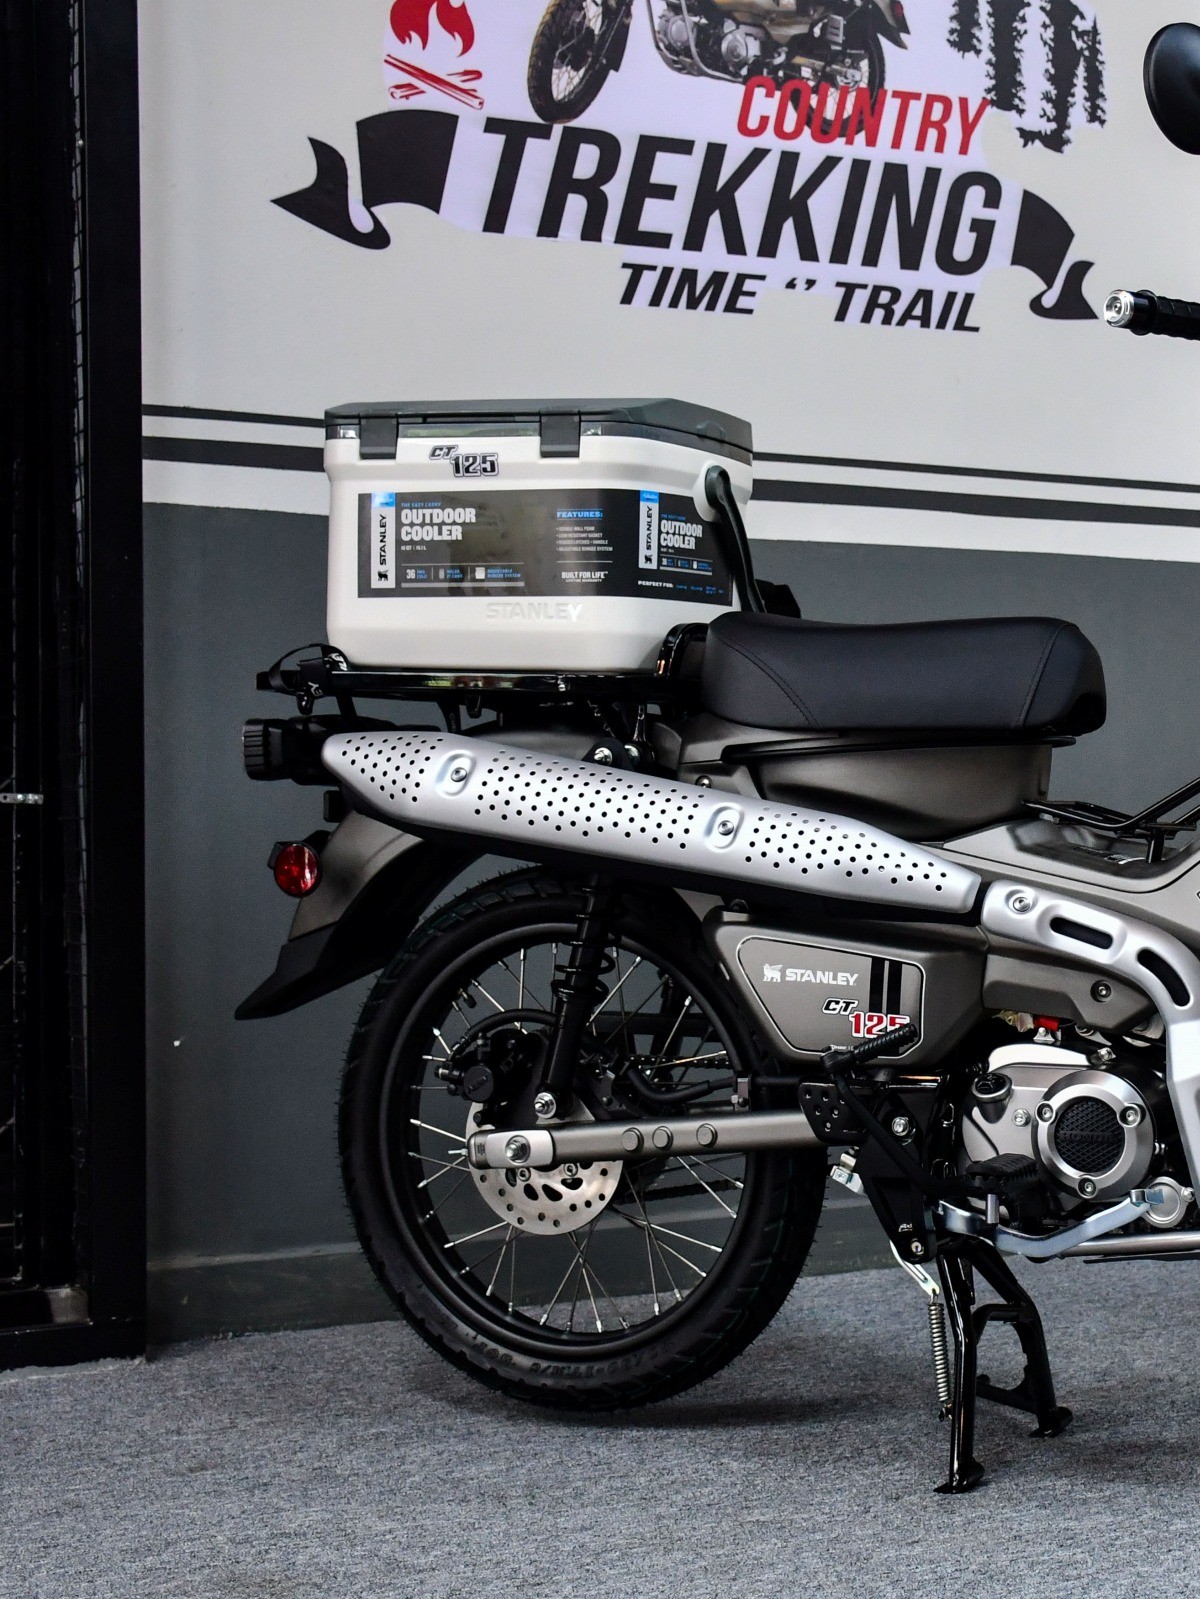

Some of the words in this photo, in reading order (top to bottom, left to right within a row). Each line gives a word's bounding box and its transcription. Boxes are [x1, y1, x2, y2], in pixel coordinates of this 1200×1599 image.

[737, 75, 991, 155] COUNTRY
[482, 117, 1002, 276] TREKKING
[619, 262, 766, 315] TIME
[833, 281, 981, 333] TRAIL
[429, 445, 458, 460] CT
[451, 453, 499, 477] 125
[401, 508, 476, 524] OUTDOOR
[401, 525, 462, 541] COOLER
[660, 520, 703, 537] OUTDOOR
[379, 514, 387, 565] STANLEY
[660, 533, 695, 550] COOLER
[406, 569, 415, 579] 36
[561, 571, 578, 579] BUILT
[579, 571, 591, 579] FOR
[486, 602, 583, 621] STANLEY
[785, 969, 858, 986] STANLEY
[822, 998, 858, 1015] CT
